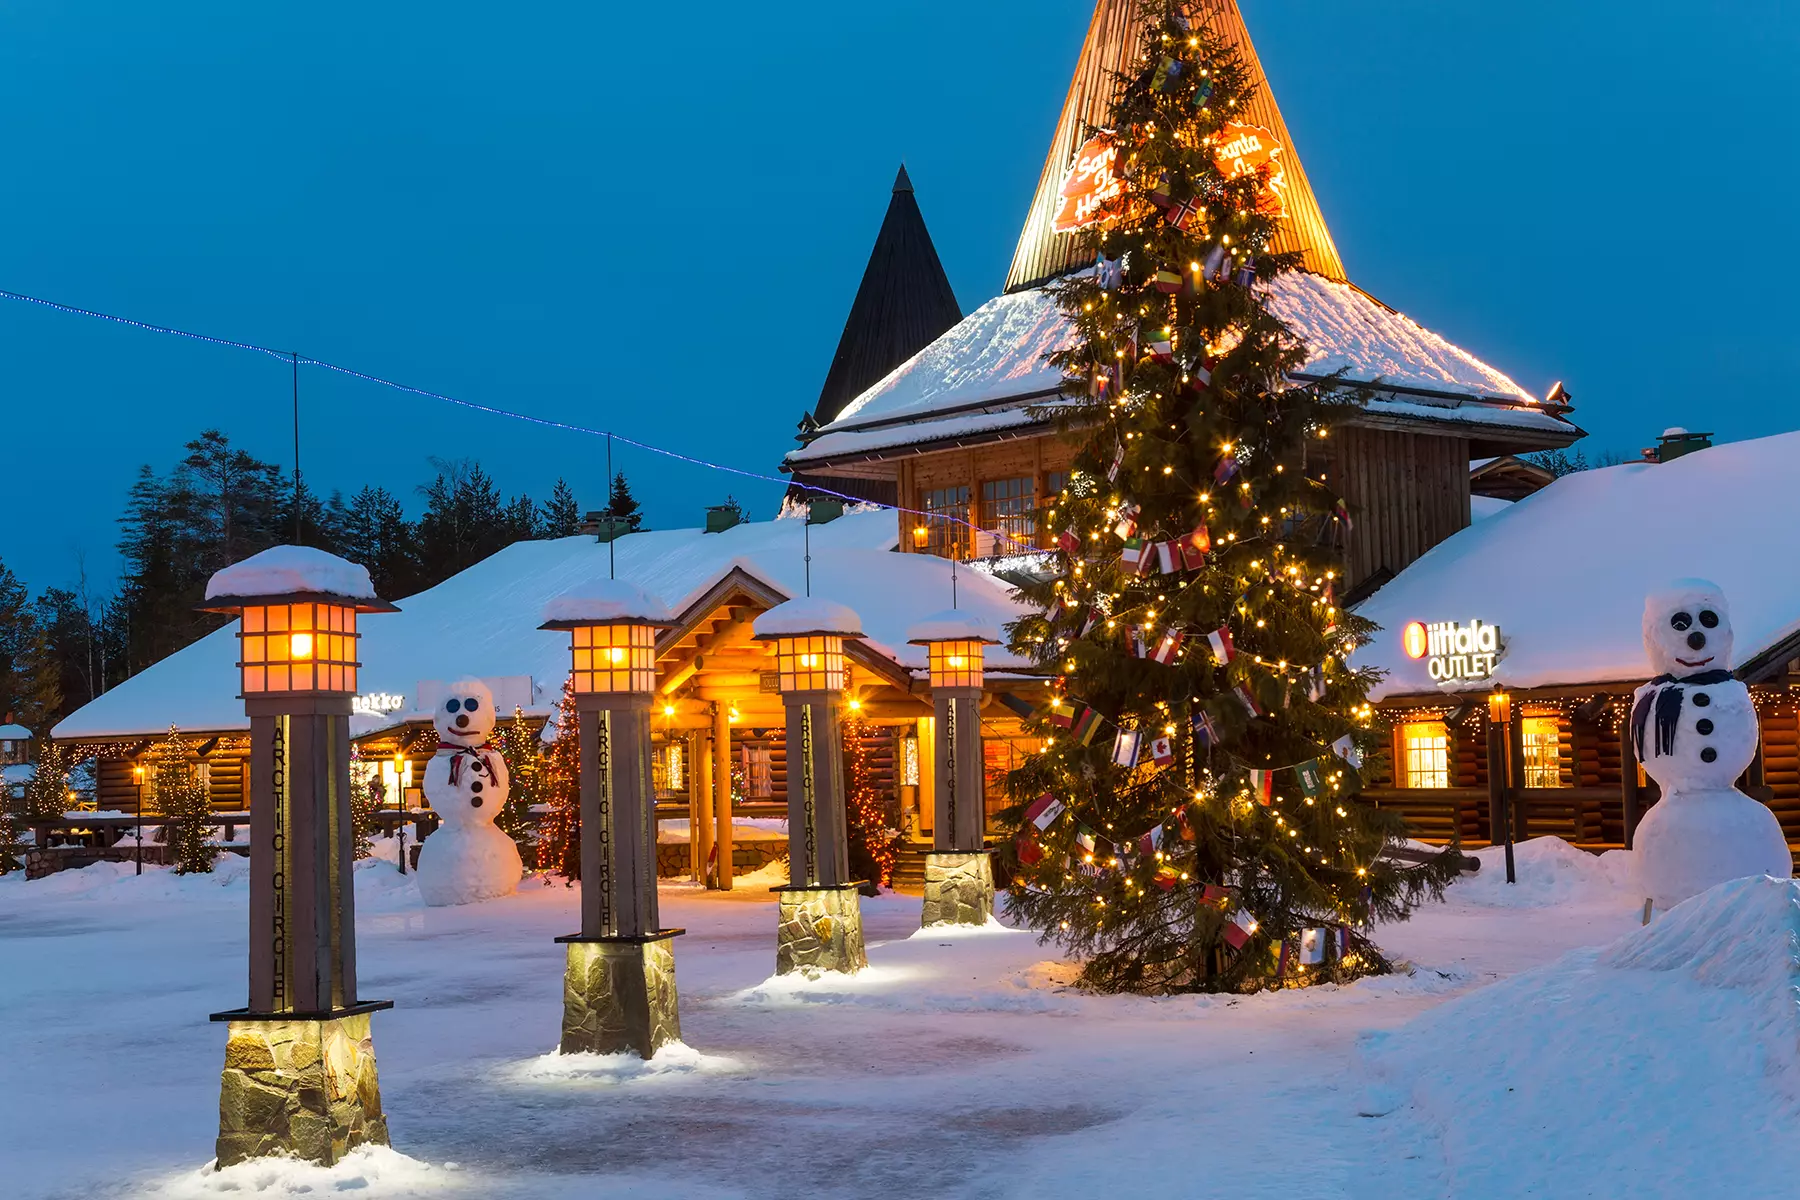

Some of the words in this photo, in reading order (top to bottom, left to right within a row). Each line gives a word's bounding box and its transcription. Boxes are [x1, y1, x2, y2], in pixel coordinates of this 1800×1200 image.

[1077, 147, 1118, 183] San
[1427, 619, 1499, 656] iittala
[1428, 653, 1495, 680] OUTLET
[597, 719, 609, 814] ARCTIC
[800, 712, 812, 788] ARCTIC
[272, 727, 285, 851] ARCTIC
[600, 830, 610, 926] CIRCLE
[804, 801, 814, 878] CIRCLE
[273, 871, 285, 998] CIRCLE
